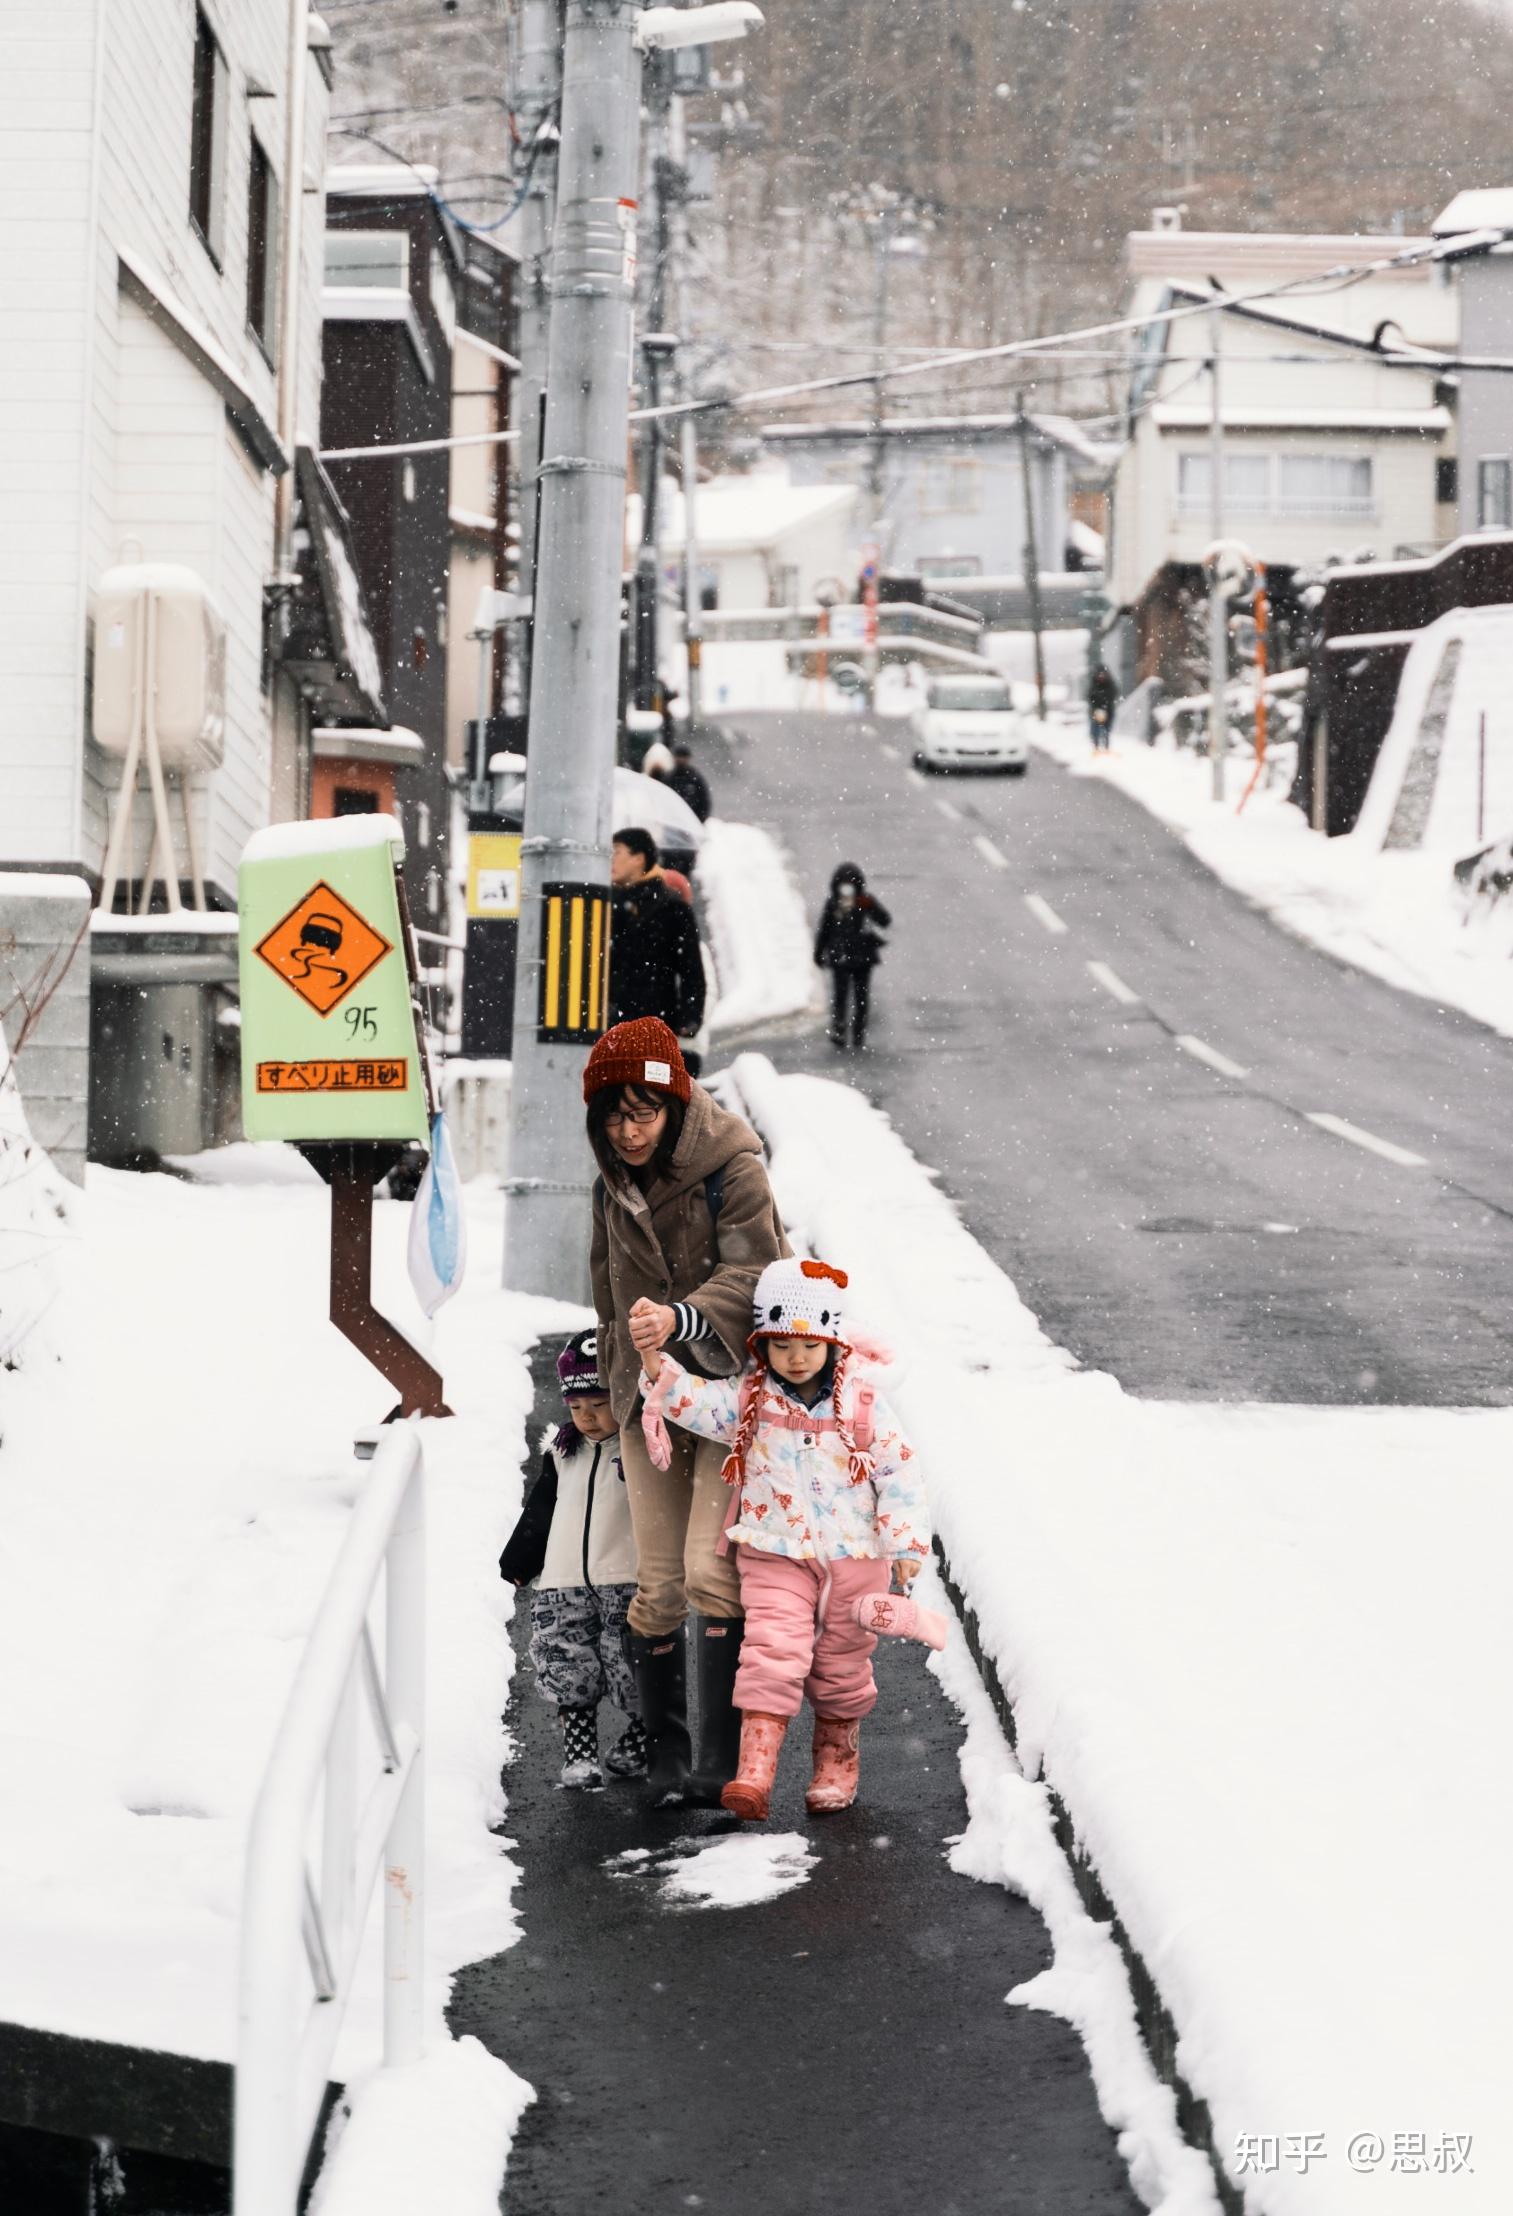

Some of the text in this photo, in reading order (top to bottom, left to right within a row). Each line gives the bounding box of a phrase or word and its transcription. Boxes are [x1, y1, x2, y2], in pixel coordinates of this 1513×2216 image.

[344, 1007, 377, 1042] 95
[265, 1064, 400, 1087] すべり止用砂
